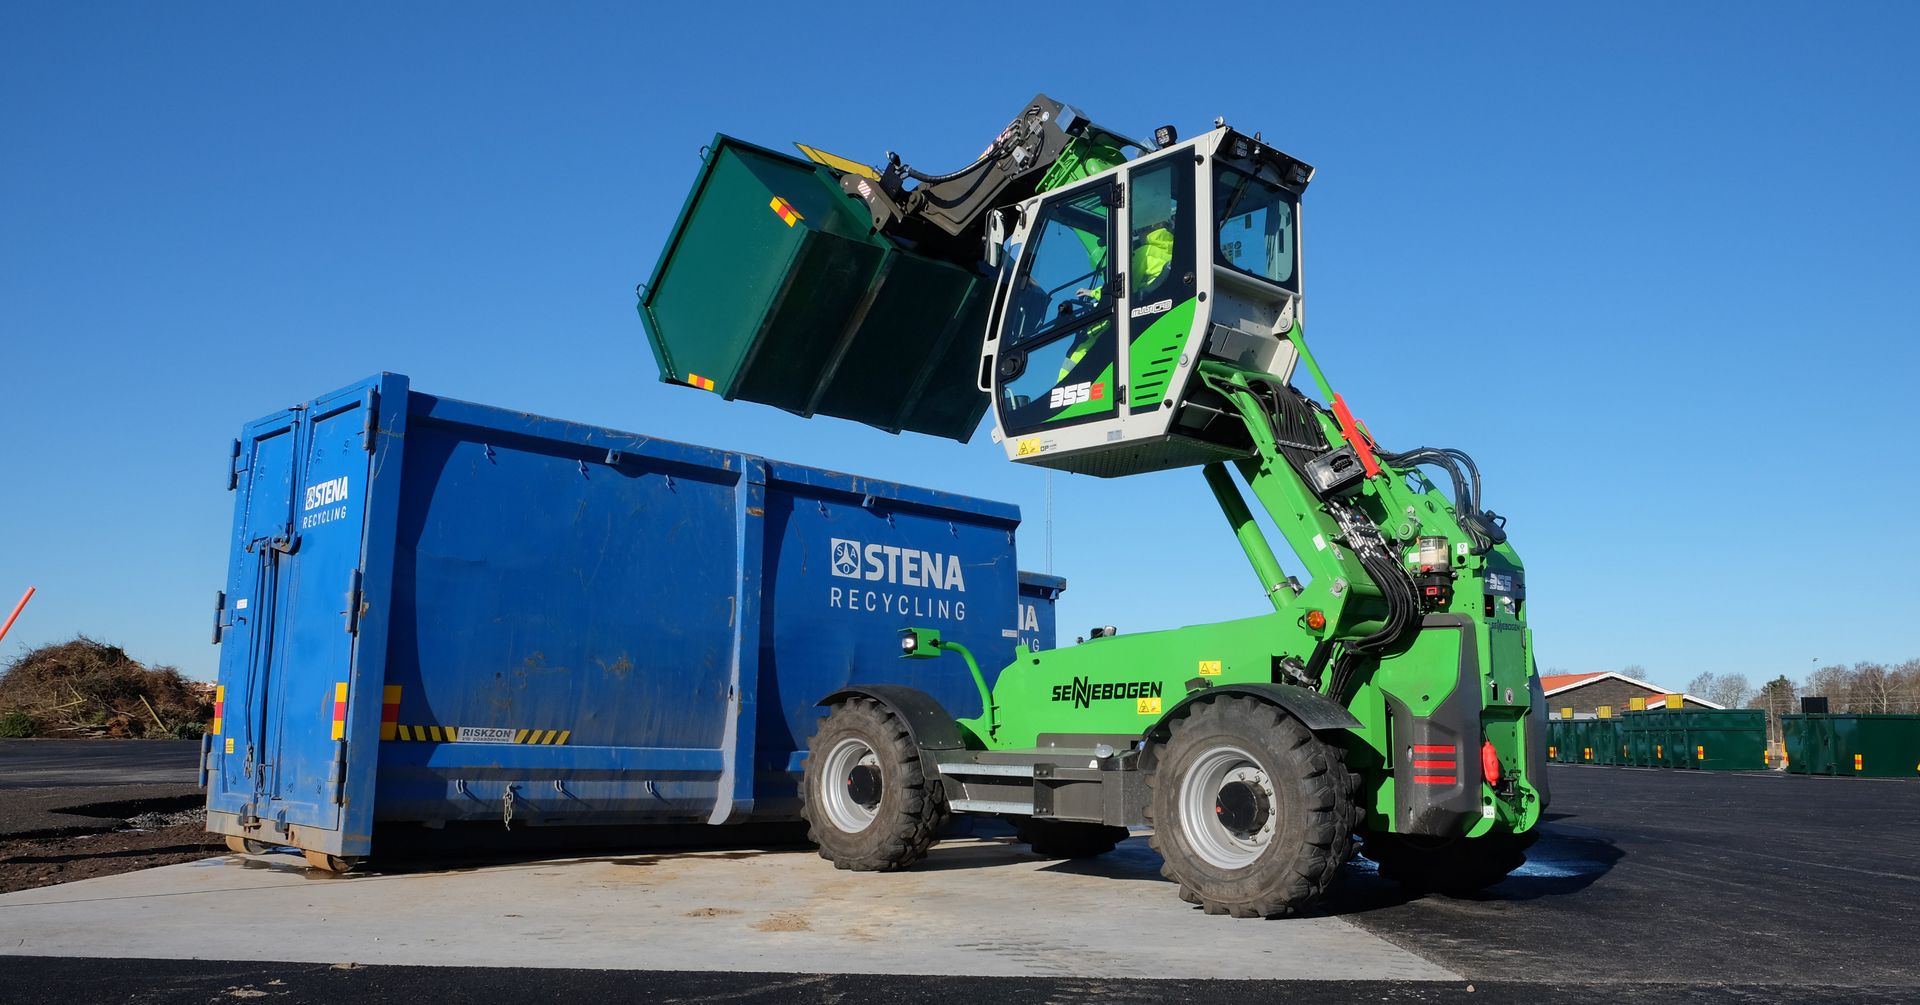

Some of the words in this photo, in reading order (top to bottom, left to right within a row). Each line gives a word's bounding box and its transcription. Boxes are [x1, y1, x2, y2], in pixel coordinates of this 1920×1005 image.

[1050, 381, 1105, 408] 355E
[314, 476, 348, 507] STENA
[302, 505, 347, 529] RECYCLING
[864, 543, 966, 592] STENA
[830, 586, 966, 621] RECYCLING
[1052, 676, 1163, 709] SENNEBOGEN
[462, 728, 512, 738] RISKZON
